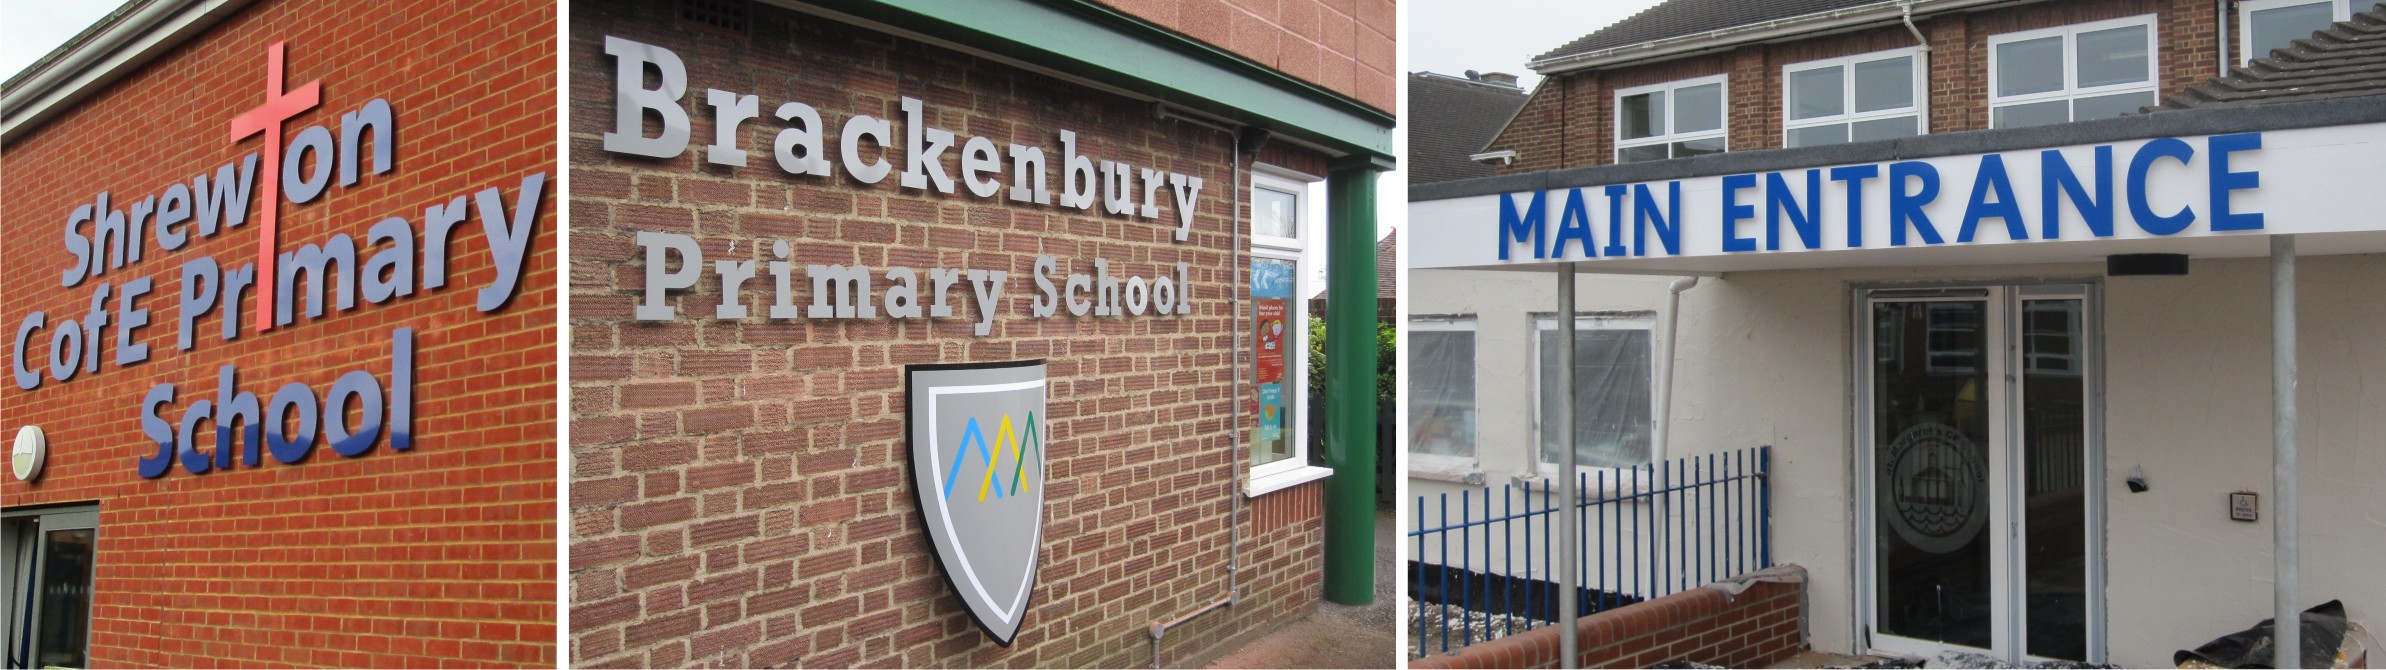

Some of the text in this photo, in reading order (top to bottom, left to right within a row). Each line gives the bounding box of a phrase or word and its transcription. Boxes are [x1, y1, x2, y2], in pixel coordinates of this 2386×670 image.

[603, 35, 1202, 241] Brackenbury
[1498, 132, 2264, 260] MAIN ENTRANCE
[635, 231, 1191, 335] Primary School
[138, 327, 413, 478] School
